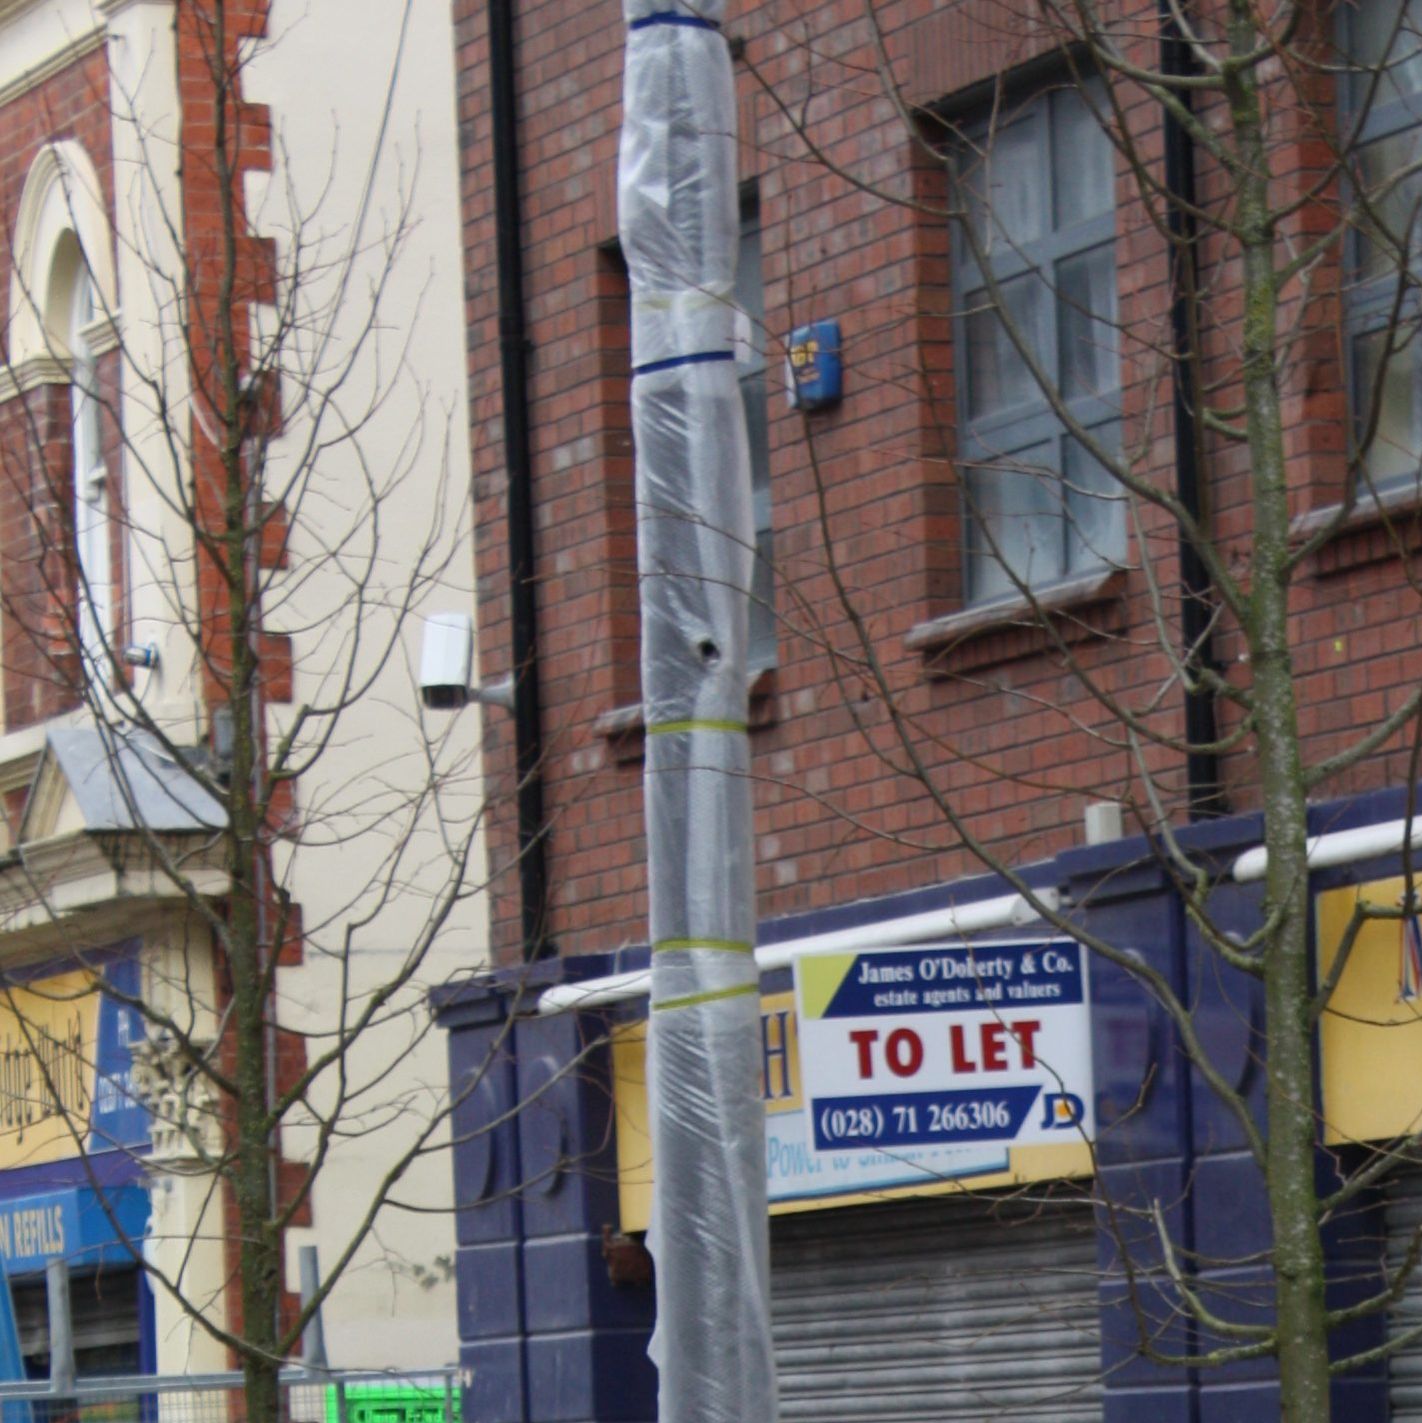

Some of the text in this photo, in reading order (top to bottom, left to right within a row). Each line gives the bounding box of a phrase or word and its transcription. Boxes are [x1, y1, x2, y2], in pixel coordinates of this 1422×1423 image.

[858, 951, 1074, 984] James O'Doherty & Co.
[874, 981, 1061, 1008] estate agents and valuers
[849, 1028, 924, 1079] TO
[949, 1020, 1041, 1073] LET
[821, 1101, 1011, 1141] (028) 71 266306
[13, 1205, 65, 1258] REFILLS
